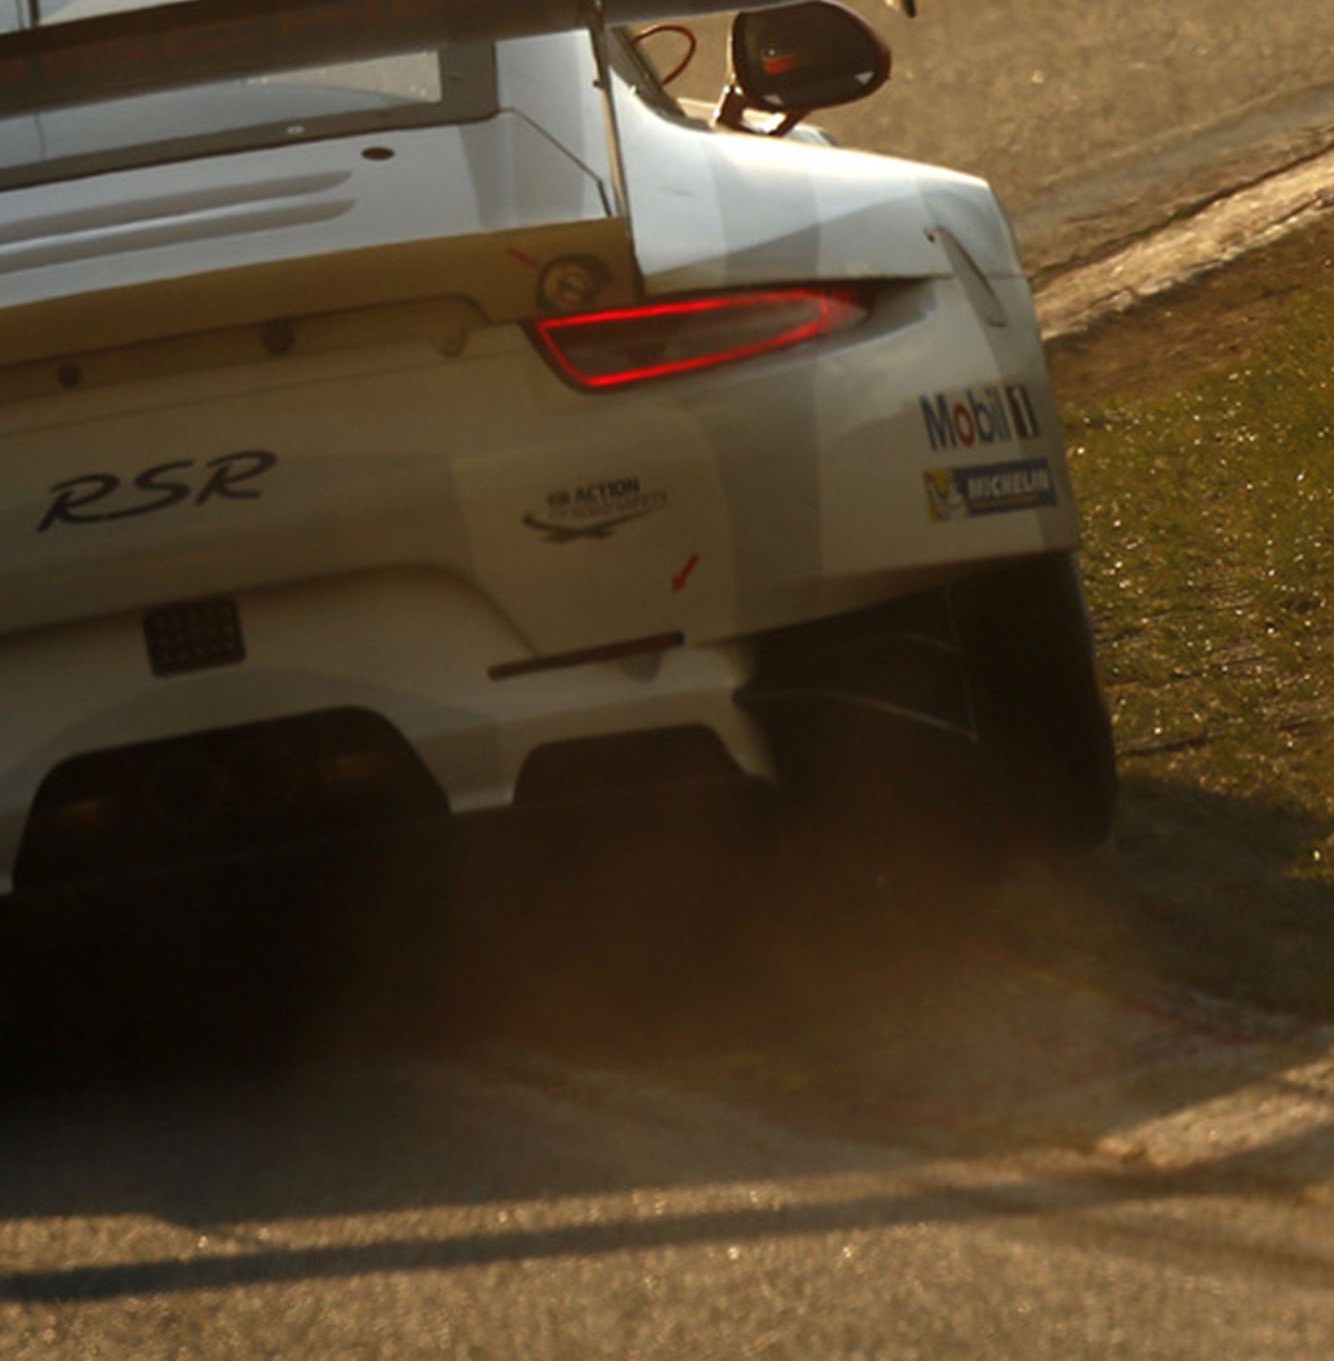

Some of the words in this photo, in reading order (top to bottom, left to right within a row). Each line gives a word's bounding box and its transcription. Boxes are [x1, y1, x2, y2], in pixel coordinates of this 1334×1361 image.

[919, 385, 1011, 452] Mobil
[1007, 384, 1038, 439] 1
[37, 450, 278, 533] RSR
[967, 469, 1050, 501] MICHELIN
